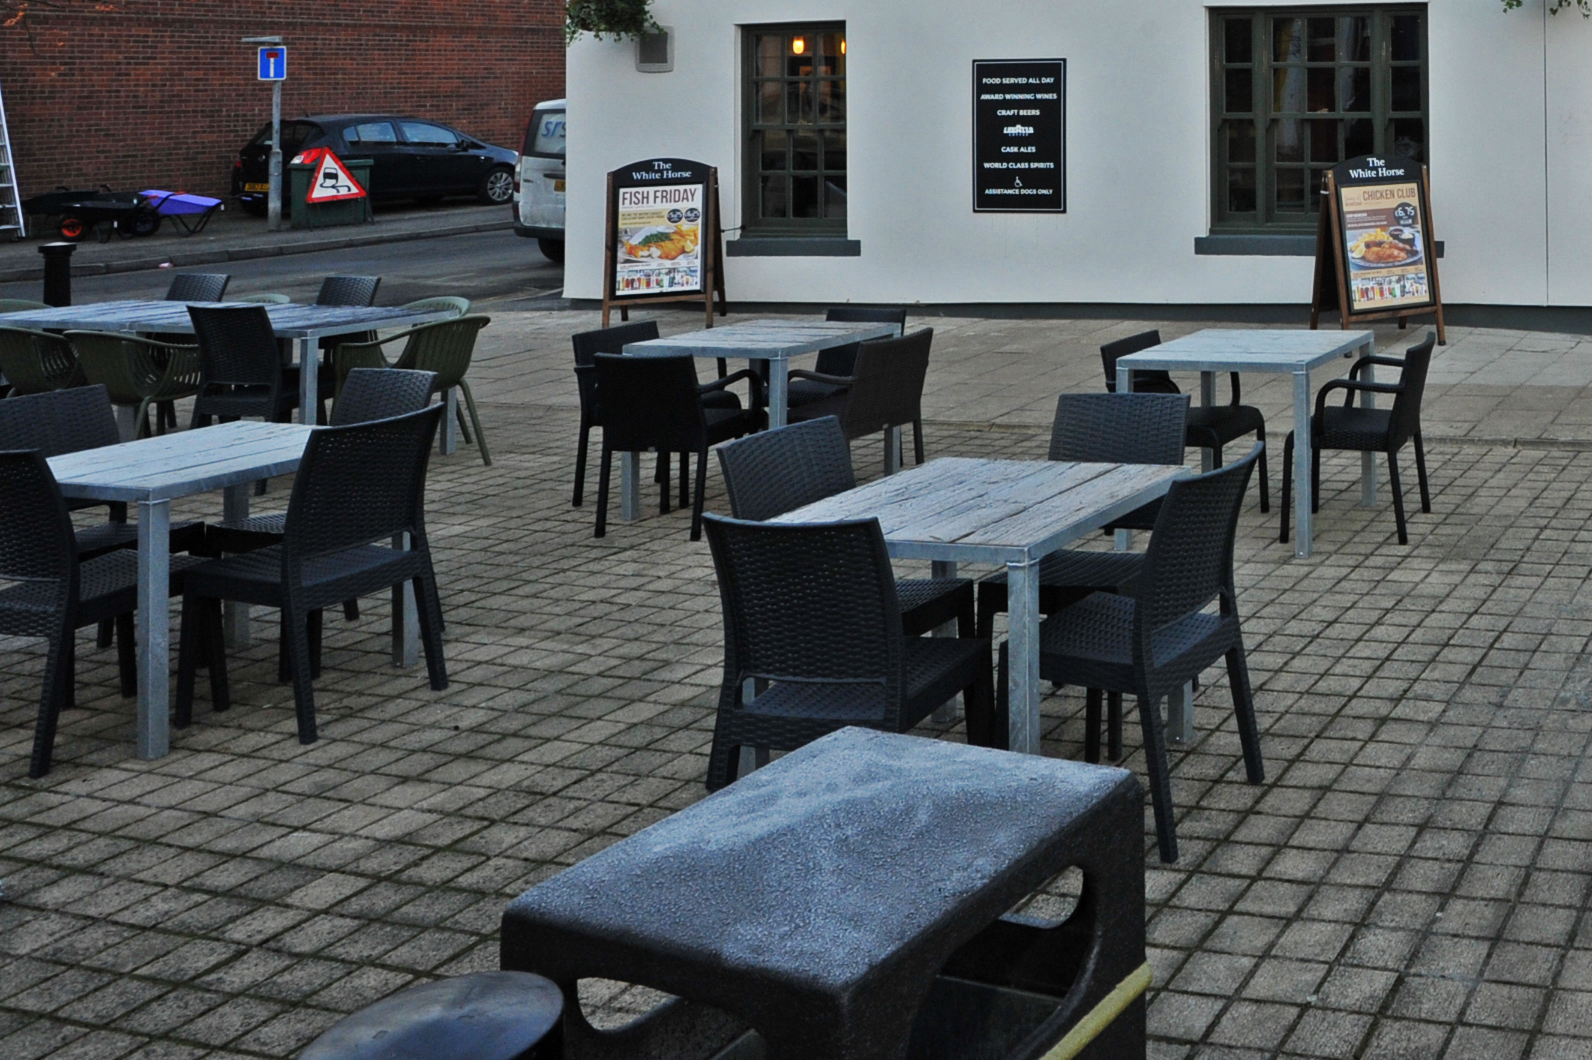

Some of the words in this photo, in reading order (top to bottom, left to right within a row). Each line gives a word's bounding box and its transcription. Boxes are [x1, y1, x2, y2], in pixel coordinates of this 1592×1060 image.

[652, 161, 672, 170] The
[1366, 157, 1385, 167] The
[632, 171, 661, 180] White
[663, 170, 692, 178] Horse
[1349, 168, 1377, 179] White
[1378, 167, 1405, 177] Horse
[621, 190, 650, 206] FISH
[653, 187, 697, 204] FRIDAY
[1362, 188, 1395, 201] CHICKEN
[1396, 187, 1416, 199] CLUB
